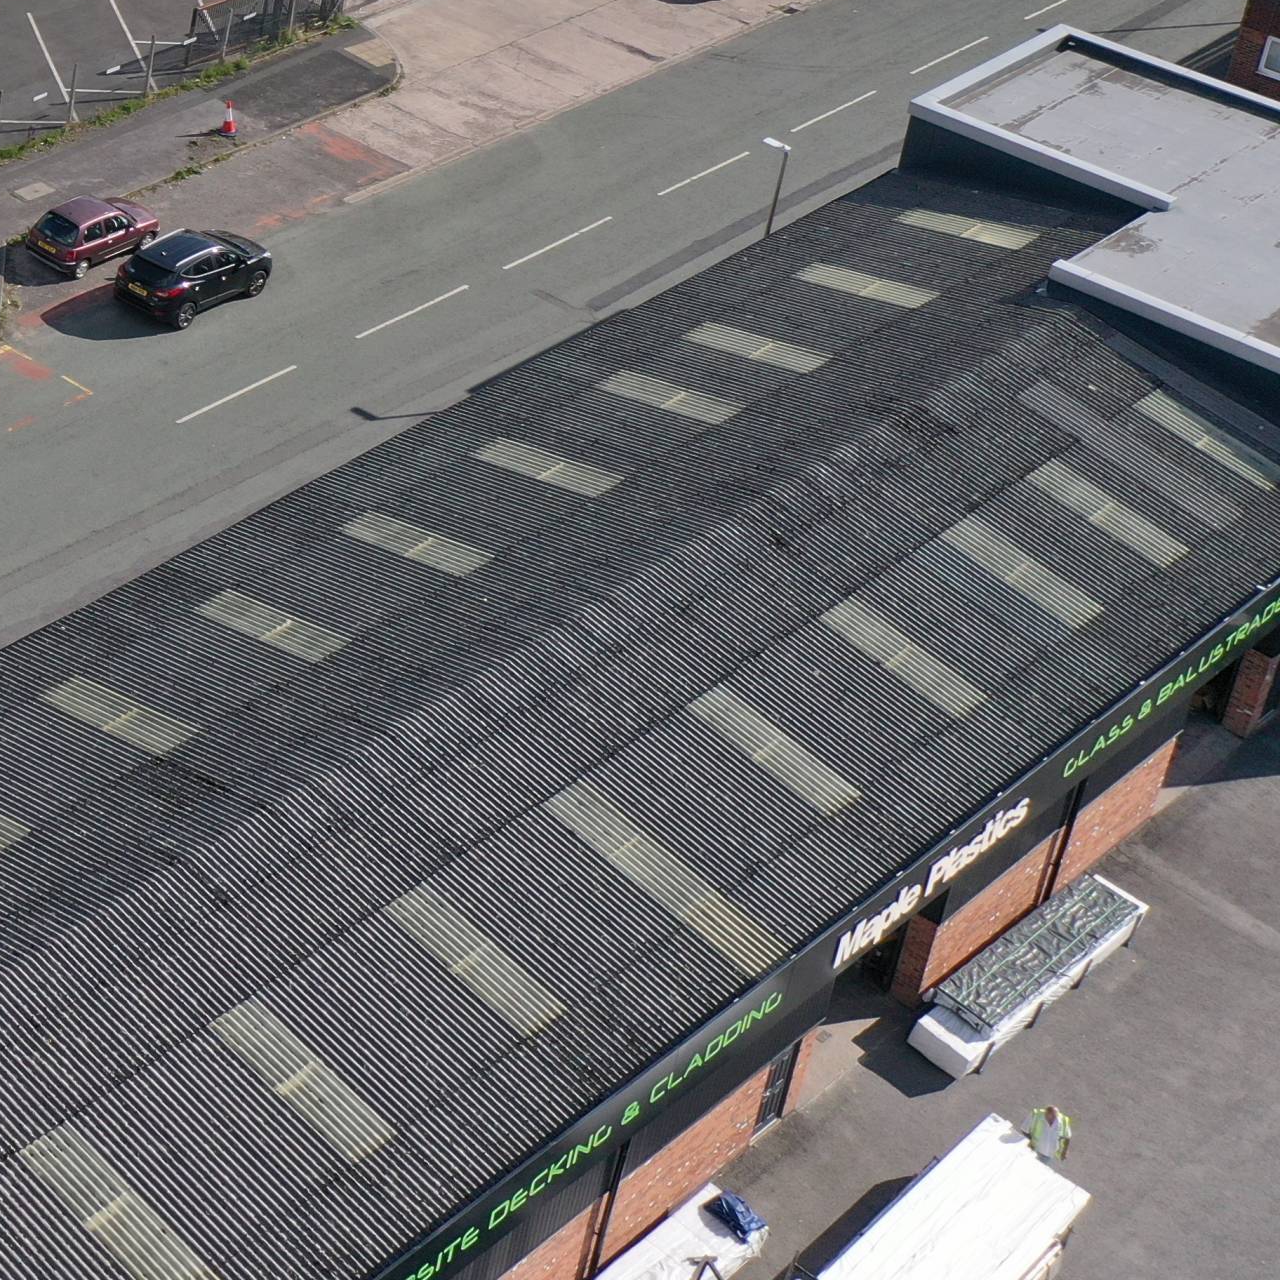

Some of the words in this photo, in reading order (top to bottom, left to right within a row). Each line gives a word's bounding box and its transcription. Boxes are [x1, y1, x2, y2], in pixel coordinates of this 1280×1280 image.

[1062, 714, 1134, 778] GLASS
[1138, 699, 1152, 720] &
[833, 884, 922, 969] Maple
[924, 797, 1030, 898] Plastics
[405, 1226, 480, 1280] SITE
[488, 1124, 612, 1230] DECKING
[620, 1101, 640, 1126] &
[649, 991, 782, 1103] CLADDING
